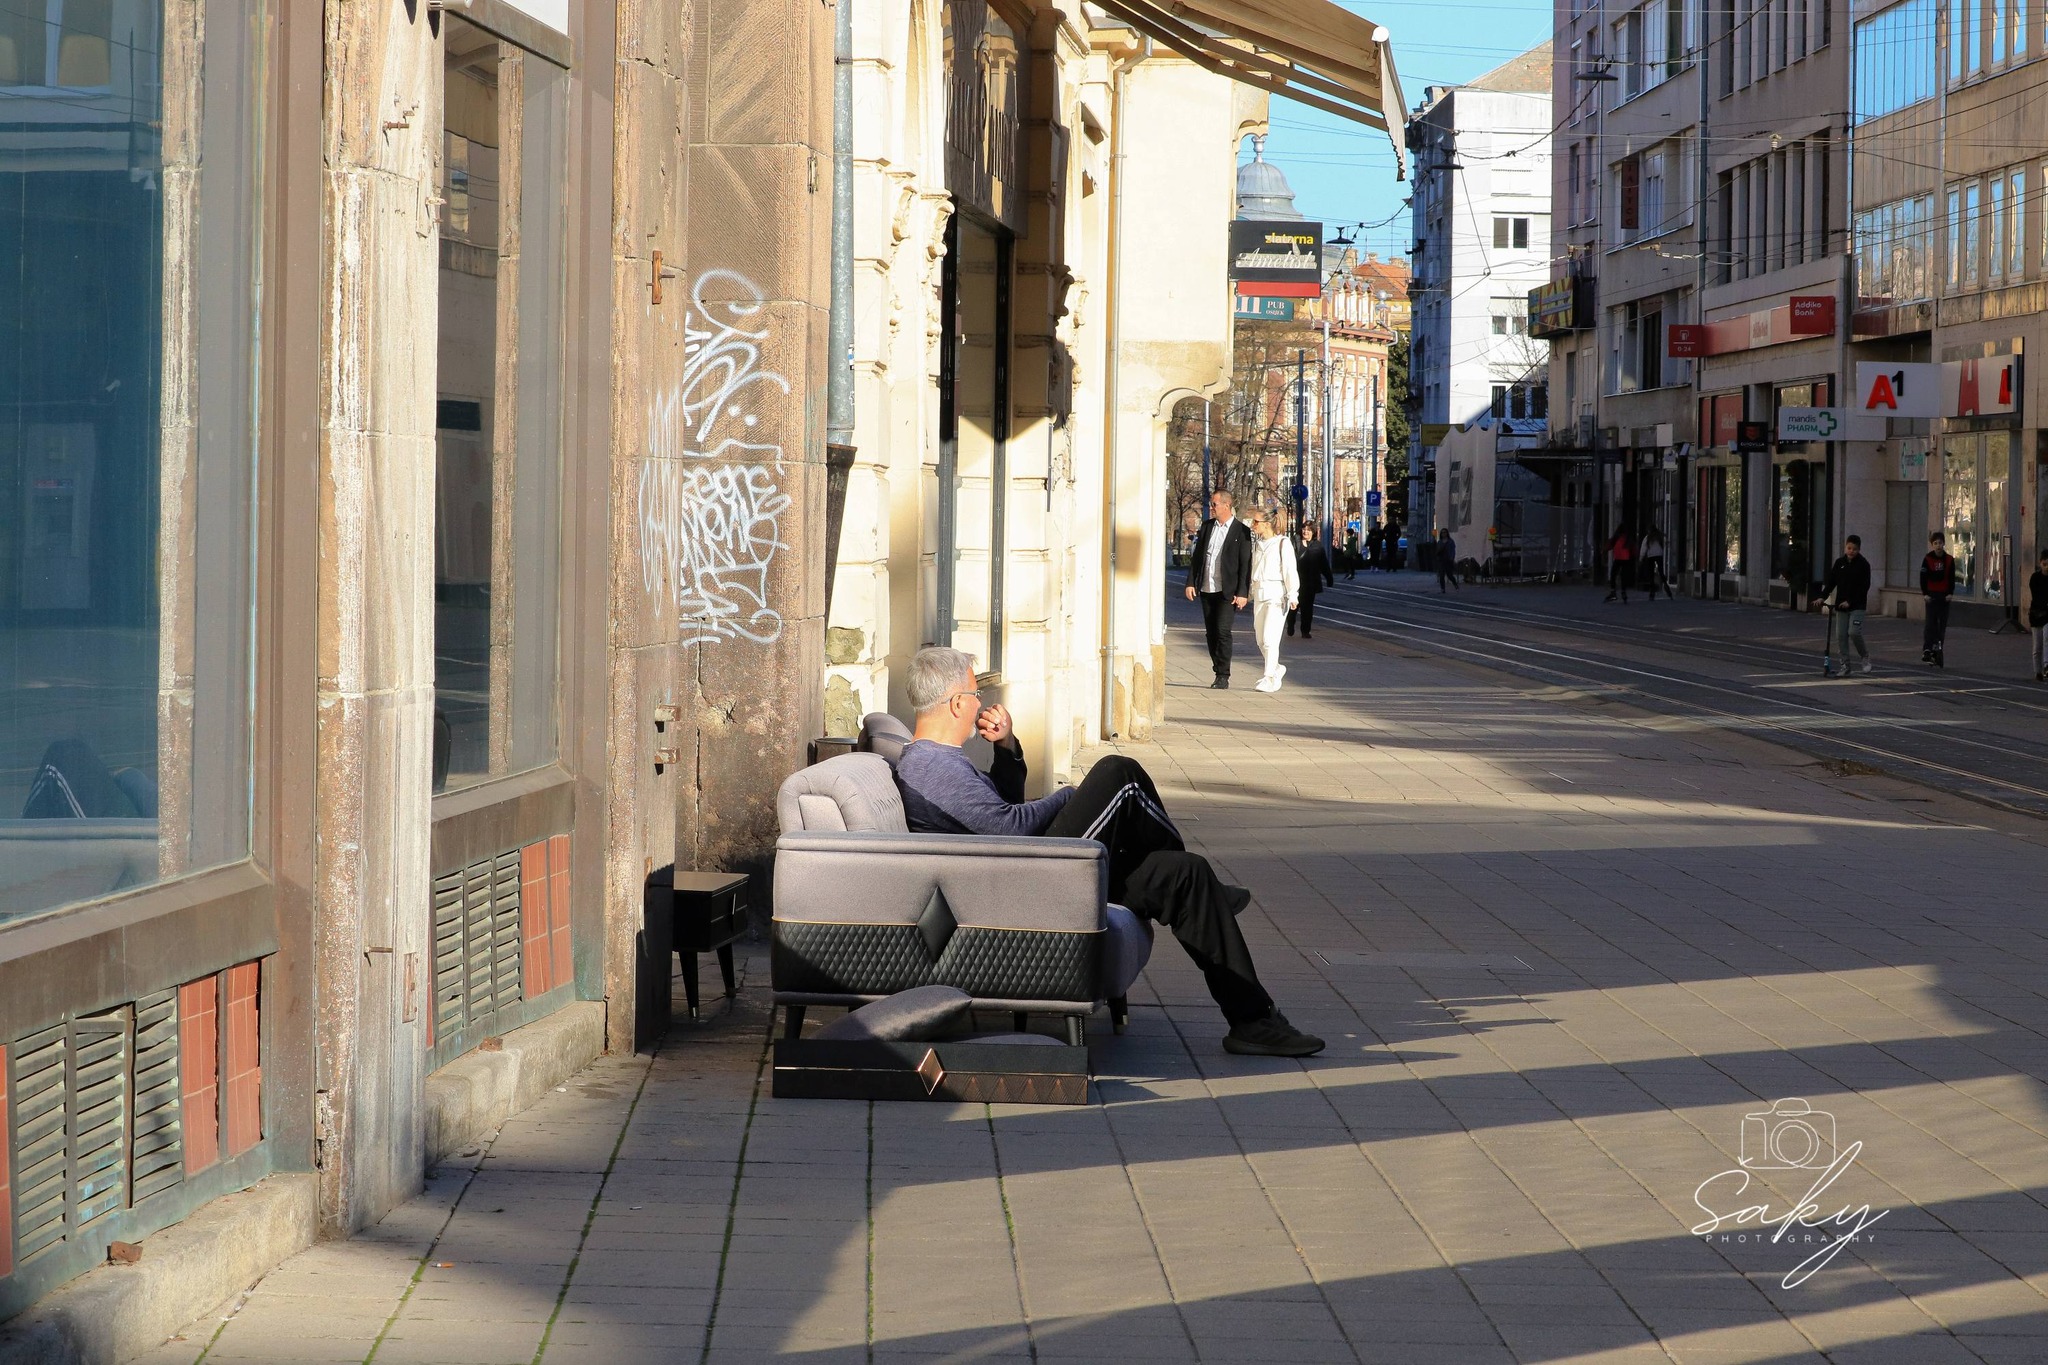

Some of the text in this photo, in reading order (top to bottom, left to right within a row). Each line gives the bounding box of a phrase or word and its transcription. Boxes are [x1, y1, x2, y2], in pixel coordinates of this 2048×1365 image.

[1265, 232, 1314, 245] zlatarna
[1267, 301, 1285, 309] PUB
[1795, 301, 1822, 309] Addiko
[1866, 370, 1904, 410] A1
[1788, 415, 1816, 423] mandis
[1787, 424, 1818, 432] PHARM
[1370, 493, 1378, 504] P
